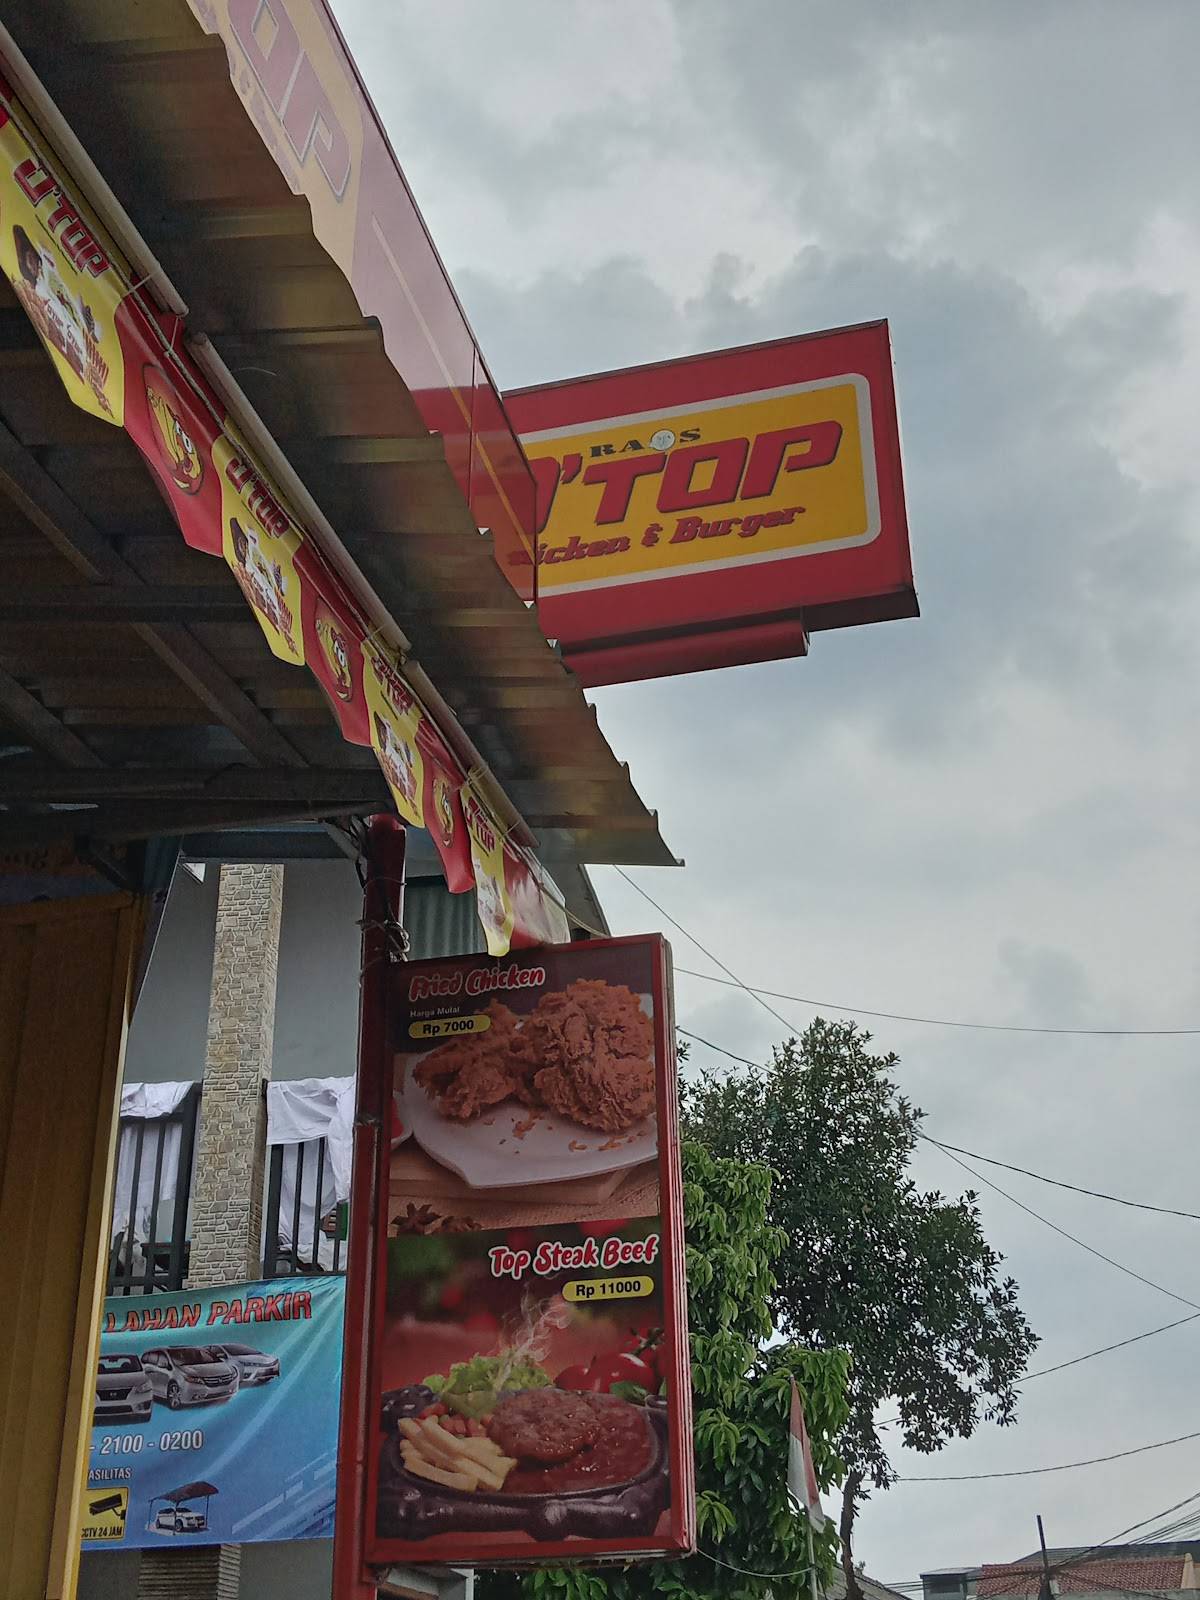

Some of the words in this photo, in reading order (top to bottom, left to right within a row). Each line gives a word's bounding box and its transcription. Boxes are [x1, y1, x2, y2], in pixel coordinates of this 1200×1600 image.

[669, 506, 806, 544] Burger
[409, 972, 462, 1002] Fried
[465, 964, 546, 997] Chicken
[422, 1023, 440, 1036] Rp
[444, 1019, 475, 1033] 7000
[488, 1245, 531, 1280] Top
[533, 1237, 600, 1275] Steak
[601, 1233, 660, 1269] Beef
[575, 1284, 595, 1299] Rp
[599, 1280, 641, 1296] 11000
[206, 1290, 312, 1326] PARKIR
[101, 1434, 144, 1455] 2100
[159, 1429, 204, 1452] 0200
